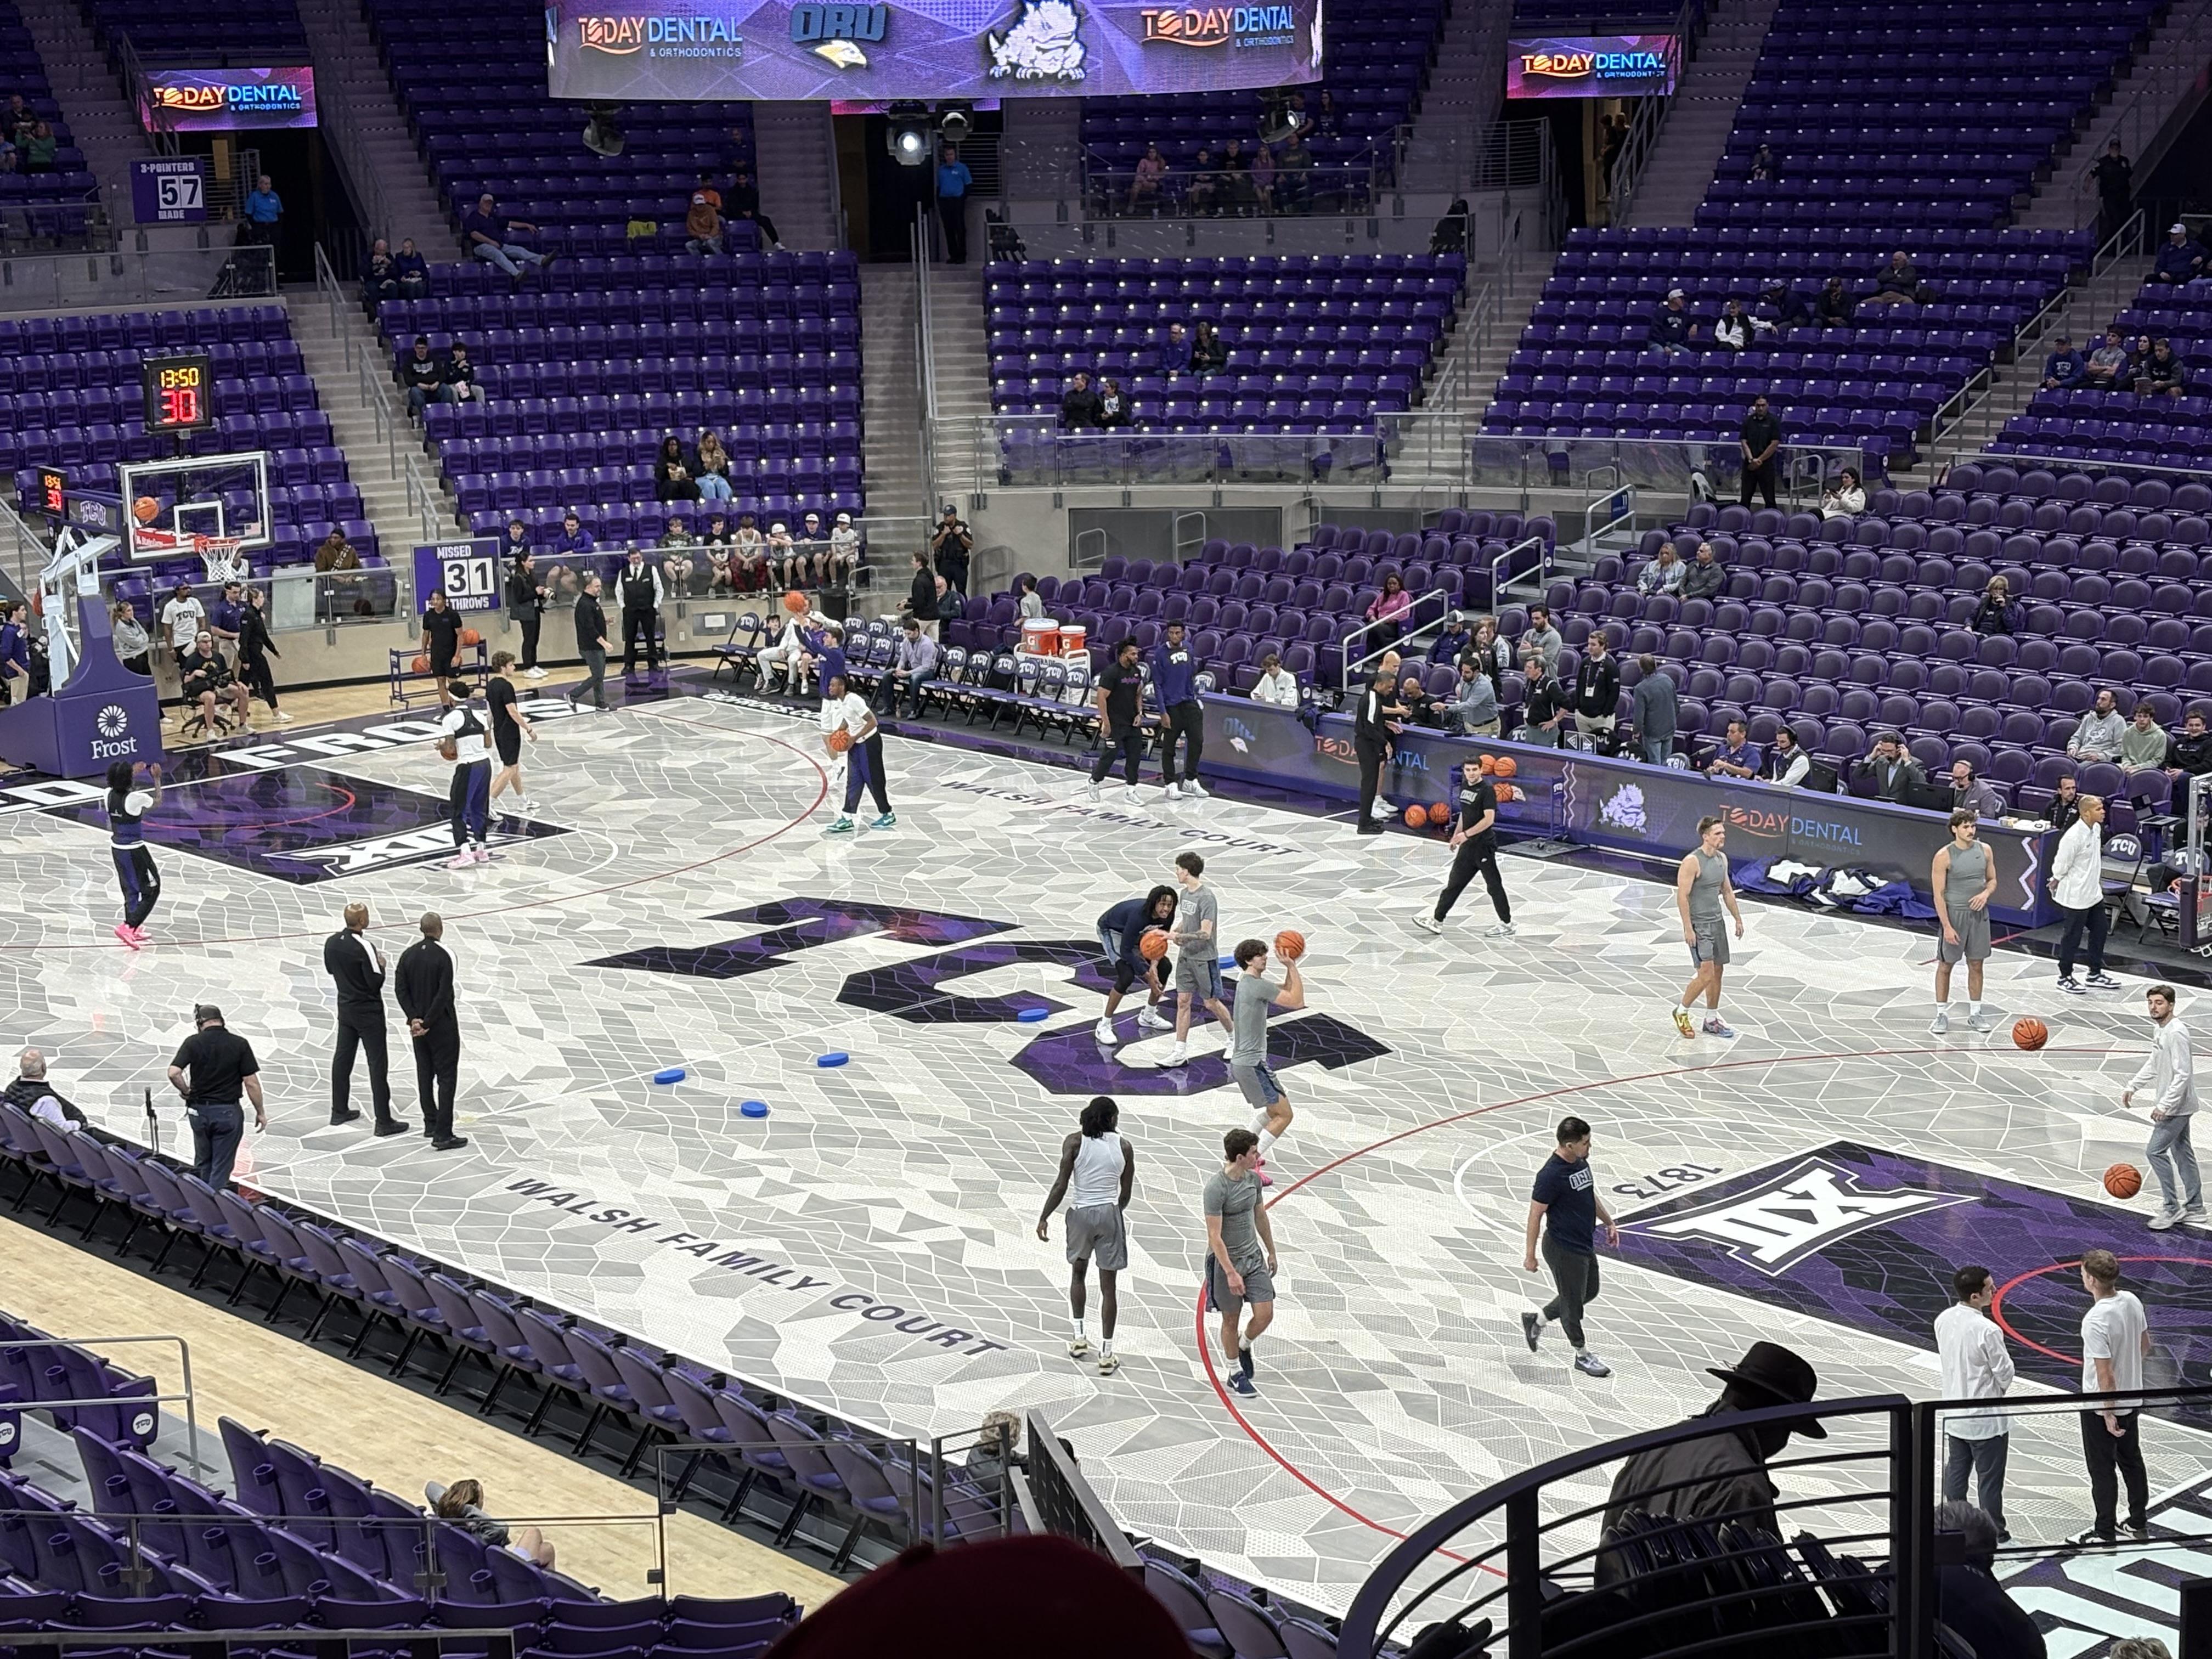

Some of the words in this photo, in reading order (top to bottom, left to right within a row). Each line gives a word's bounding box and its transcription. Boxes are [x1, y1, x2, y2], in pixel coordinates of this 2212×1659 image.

[791, 3, 887, 43] ORU
[1141, 8, 1233, 36] TODAY
[1235, 5, 1295, 32] DENTAL
[578, 16, 645, 44] TODAY
[648, 17, 743, 43] DENTAL
[650, 48, 656, 57] &
[659, 47, 742, 57] ORTHODONTICS
[1521, 53, 1594, 71] TODAY
[228, 84, 302, 103] DENTAL
[140, 162, 195, 173] 3-POINTERS
[161, 179, 200, 206] 57
[158, 210, 185, 219] MADE
[160, 368, 200, 388] 13:50
[161, 390, 196, 423] 30
[80, 500, 106, 527] TCU
[437, 545, 472, 559] MISSED
[448, 562, 488, 592] 31
[450, 596, 489, 610] THROWS
[176, 610, 195, 622] TCU
[740, 616, 755, 628] TCU
[845, 618, 862, 629] TCU
[868, 622, 884, 633] TCU
[852, 633, 867, 645] TCU
[875, 638, 890, 650] TCU
[1028, 635, 1035, 645] G
[1062, 639, 1070, 649] G
[947, 649, 963, 661] TCU
[972, 654, 988, 665] TCU
[1171, 651, 1188, 664] TCU
[998, 658, 1013, 673] TCU
[1019, 662, 1035, 674] TCU
[1046, 666, 1062, 679] TCU
[1067, 671, 1084, 684] TCU
[1512, 729, 1526, 741] TC
[91, 736, 138, 760] Frost
[1387, 751, 1430, 770] NTAL
[940, 780, 1052, 805] WALSH
[1054, 804, 1176, 830] FAMILY
[1180, 828, 1302, 856] COURT
[1719, 805, 1790, 833] TODAY
[1791, 817, 1863, 845] DENTAL
[2111, 838, 2137, 856] TCU
[574, 896, 1394, 1096] TCU
[1612, 1162, 1724, 1200] 1873
[1646, 1167, 1939, 1264] XII
[505, 1178, 661, 1234] WALSH
[658, 1232, 831, 1291] FAMILY
[829, 1294, 1009, 1357] COURT
[136, 1419, 151, 1430] TCU
